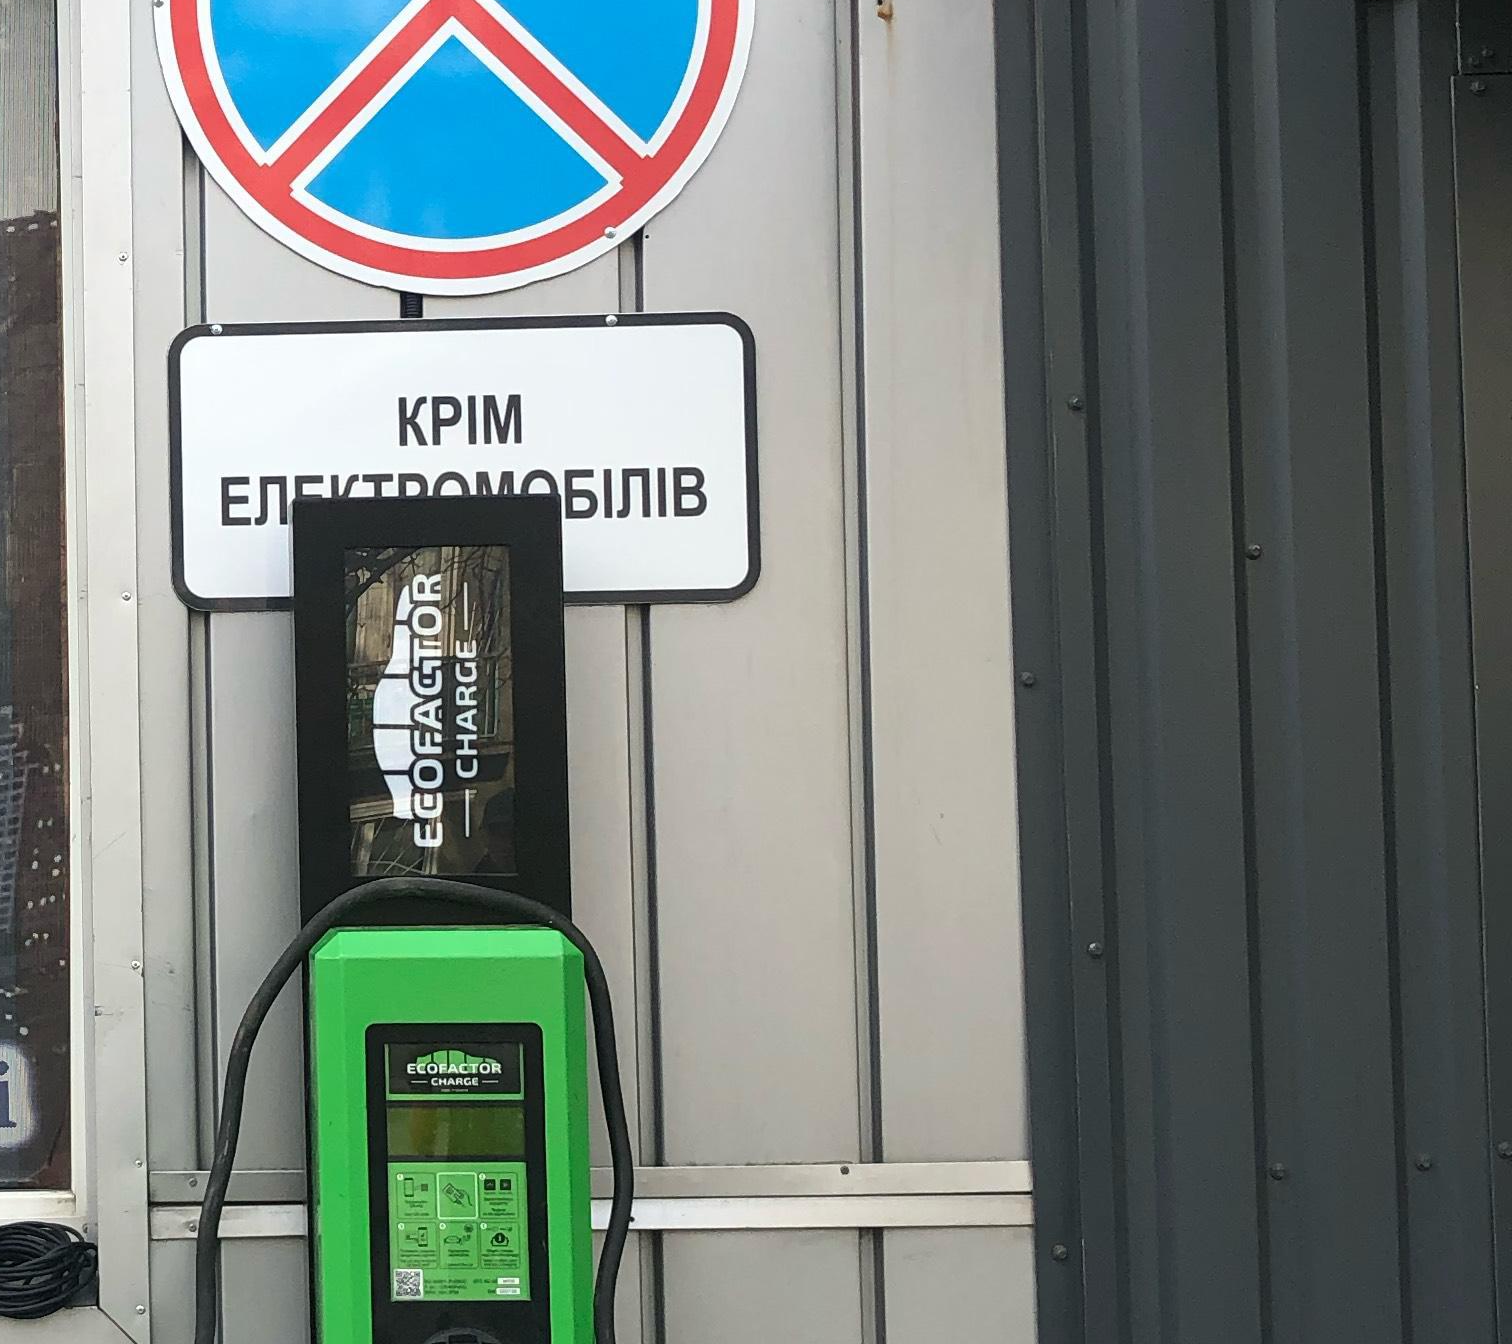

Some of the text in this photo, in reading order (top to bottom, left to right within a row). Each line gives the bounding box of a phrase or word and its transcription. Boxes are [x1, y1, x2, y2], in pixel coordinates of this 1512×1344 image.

[397, 394, 523, 447] КРІМ
[413, 573, 444, 849] ECOFACTOR
[455, 638, 478, 780] CHARGE
[406, 1063, 503, 1075] ECOFACTOR
[430, 1077, 479, 1086] CHARGE
